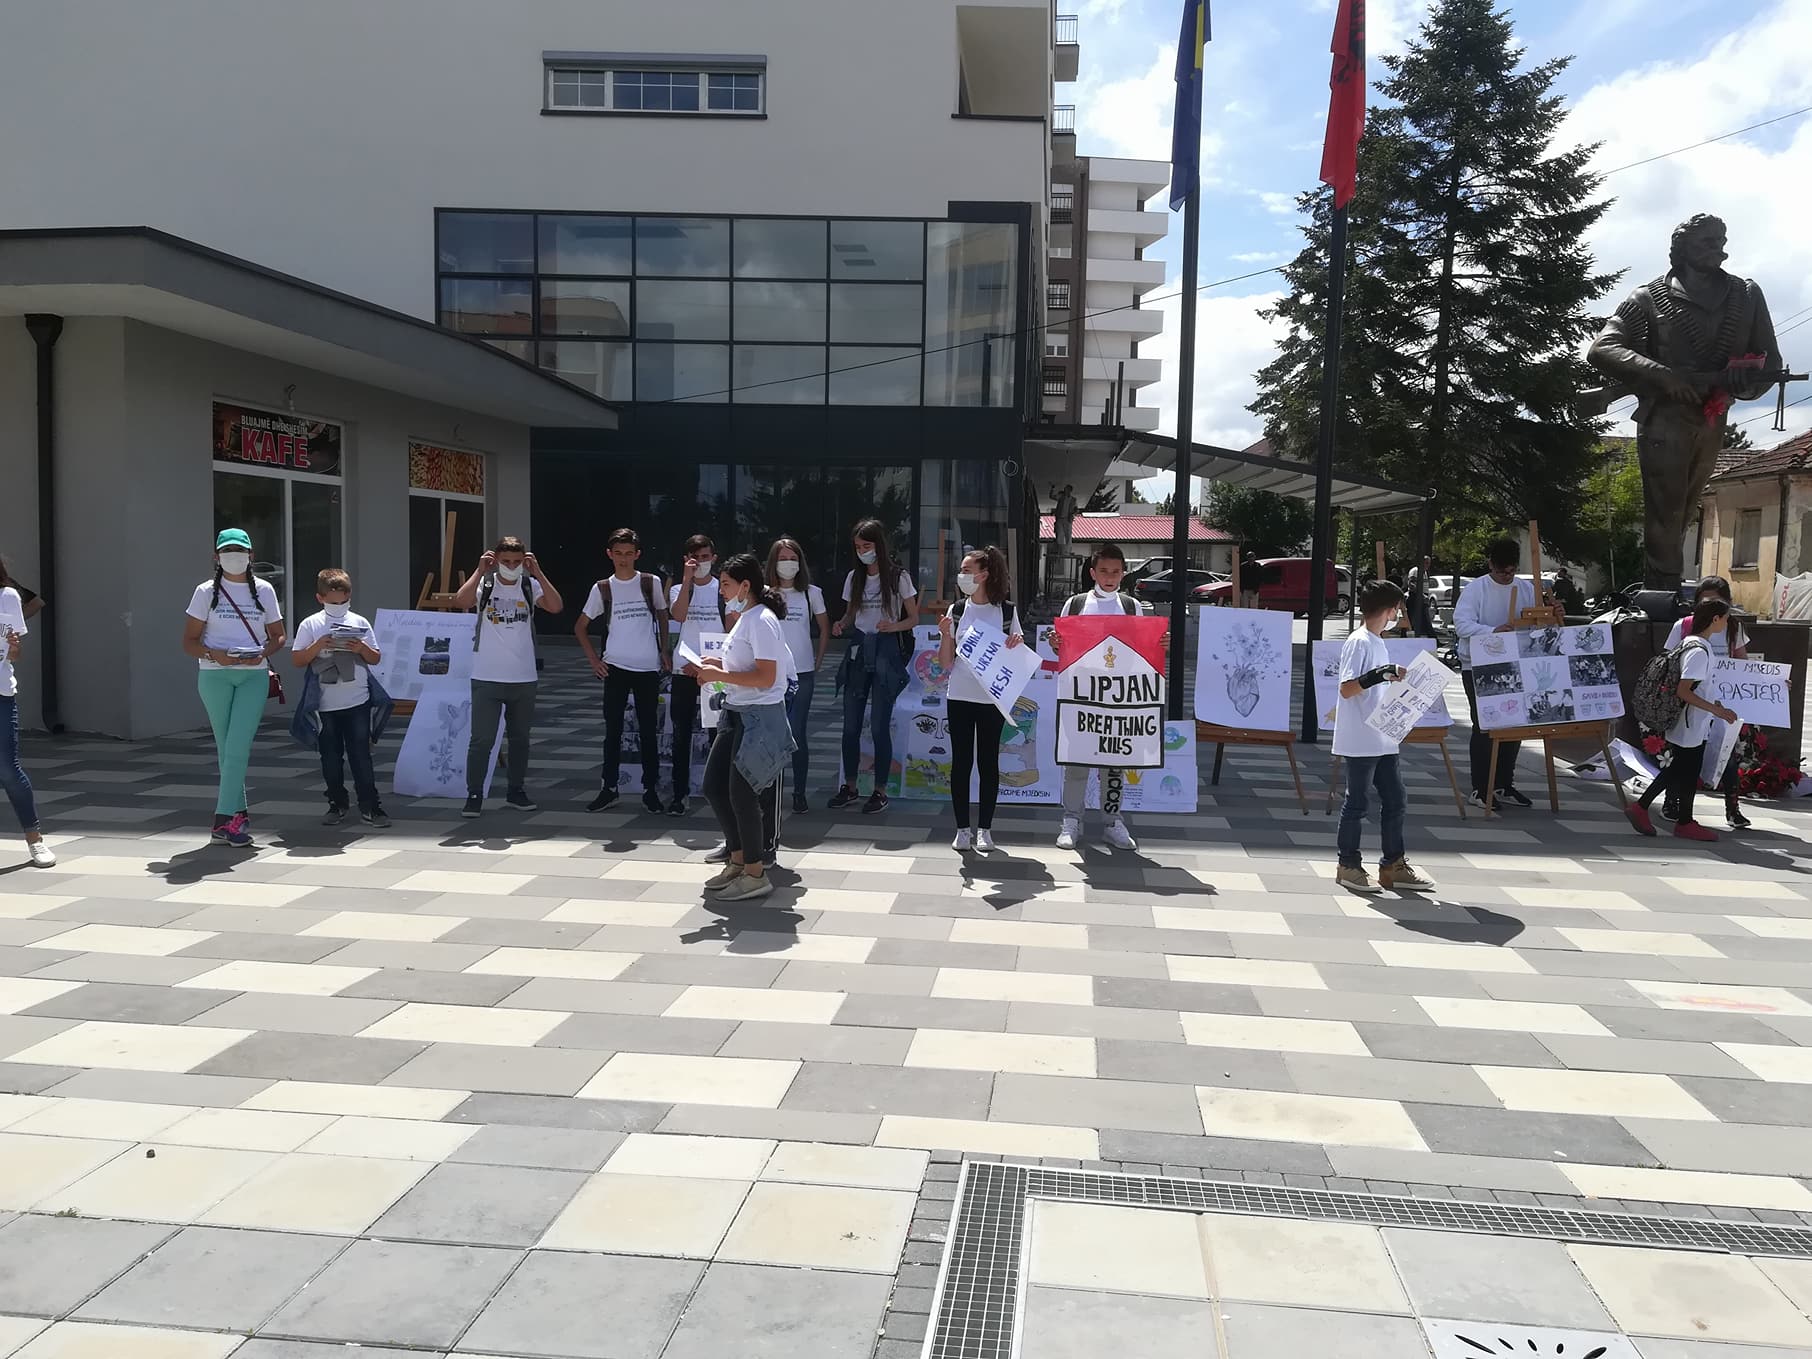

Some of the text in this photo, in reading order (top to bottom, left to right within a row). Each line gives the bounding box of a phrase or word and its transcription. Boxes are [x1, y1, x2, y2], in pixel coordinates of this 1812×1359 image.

[241, 427, 309, 468] KAFE
[1073, 672, 1160, 703] LIPJAN
[1098, 736, 1133, 756] KILLS
